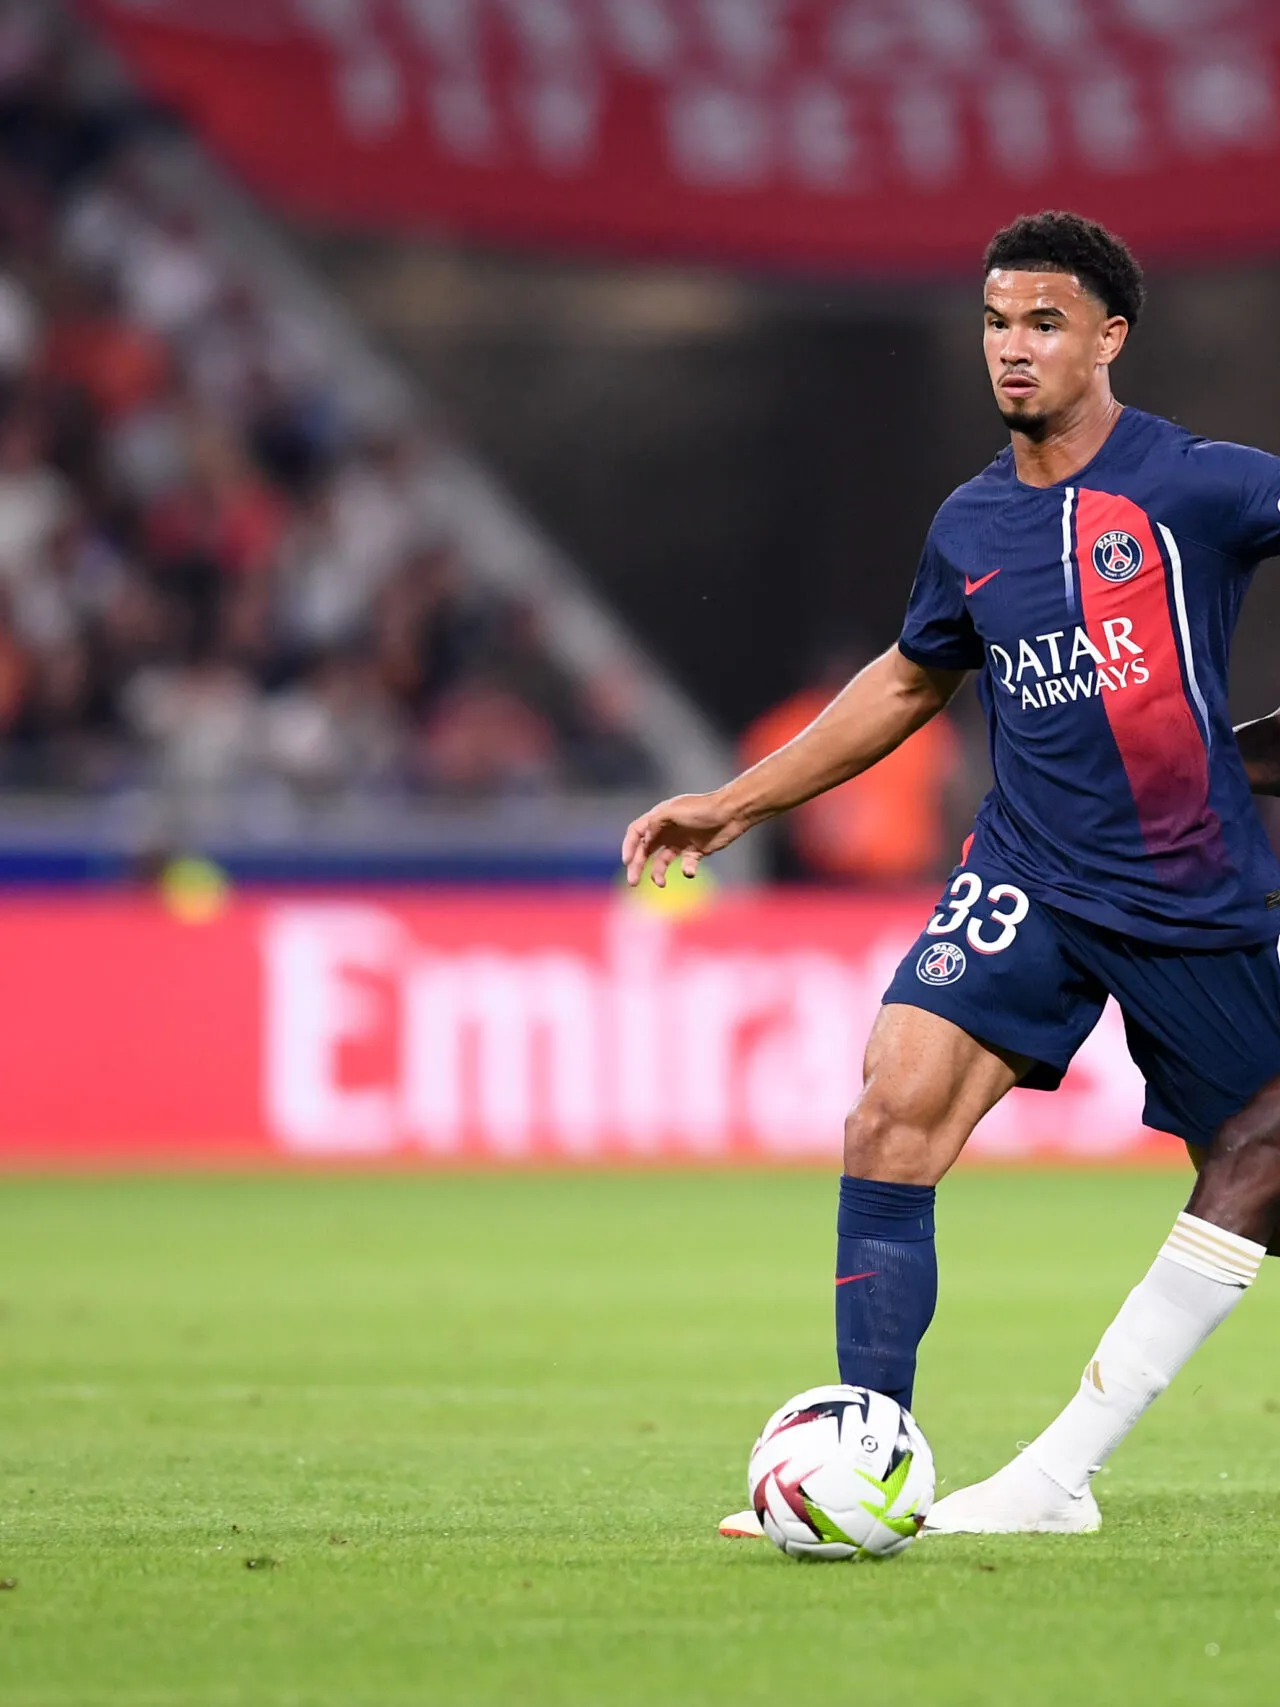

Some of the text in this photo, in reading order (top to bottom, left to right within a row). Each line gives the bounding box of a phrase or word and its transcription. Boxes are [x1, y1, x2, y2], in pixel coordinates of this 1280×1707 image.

[1097, 533, 1129, 550] PARIS
[989, 616, 1144, 694] QATAR
[1021, 657, 1150, 710] AIRWAYS
[926, 871, 1030, 955] 33
[933, 944, 963, 961] PARIS
[262, 903, 1150, 1153] Emira
